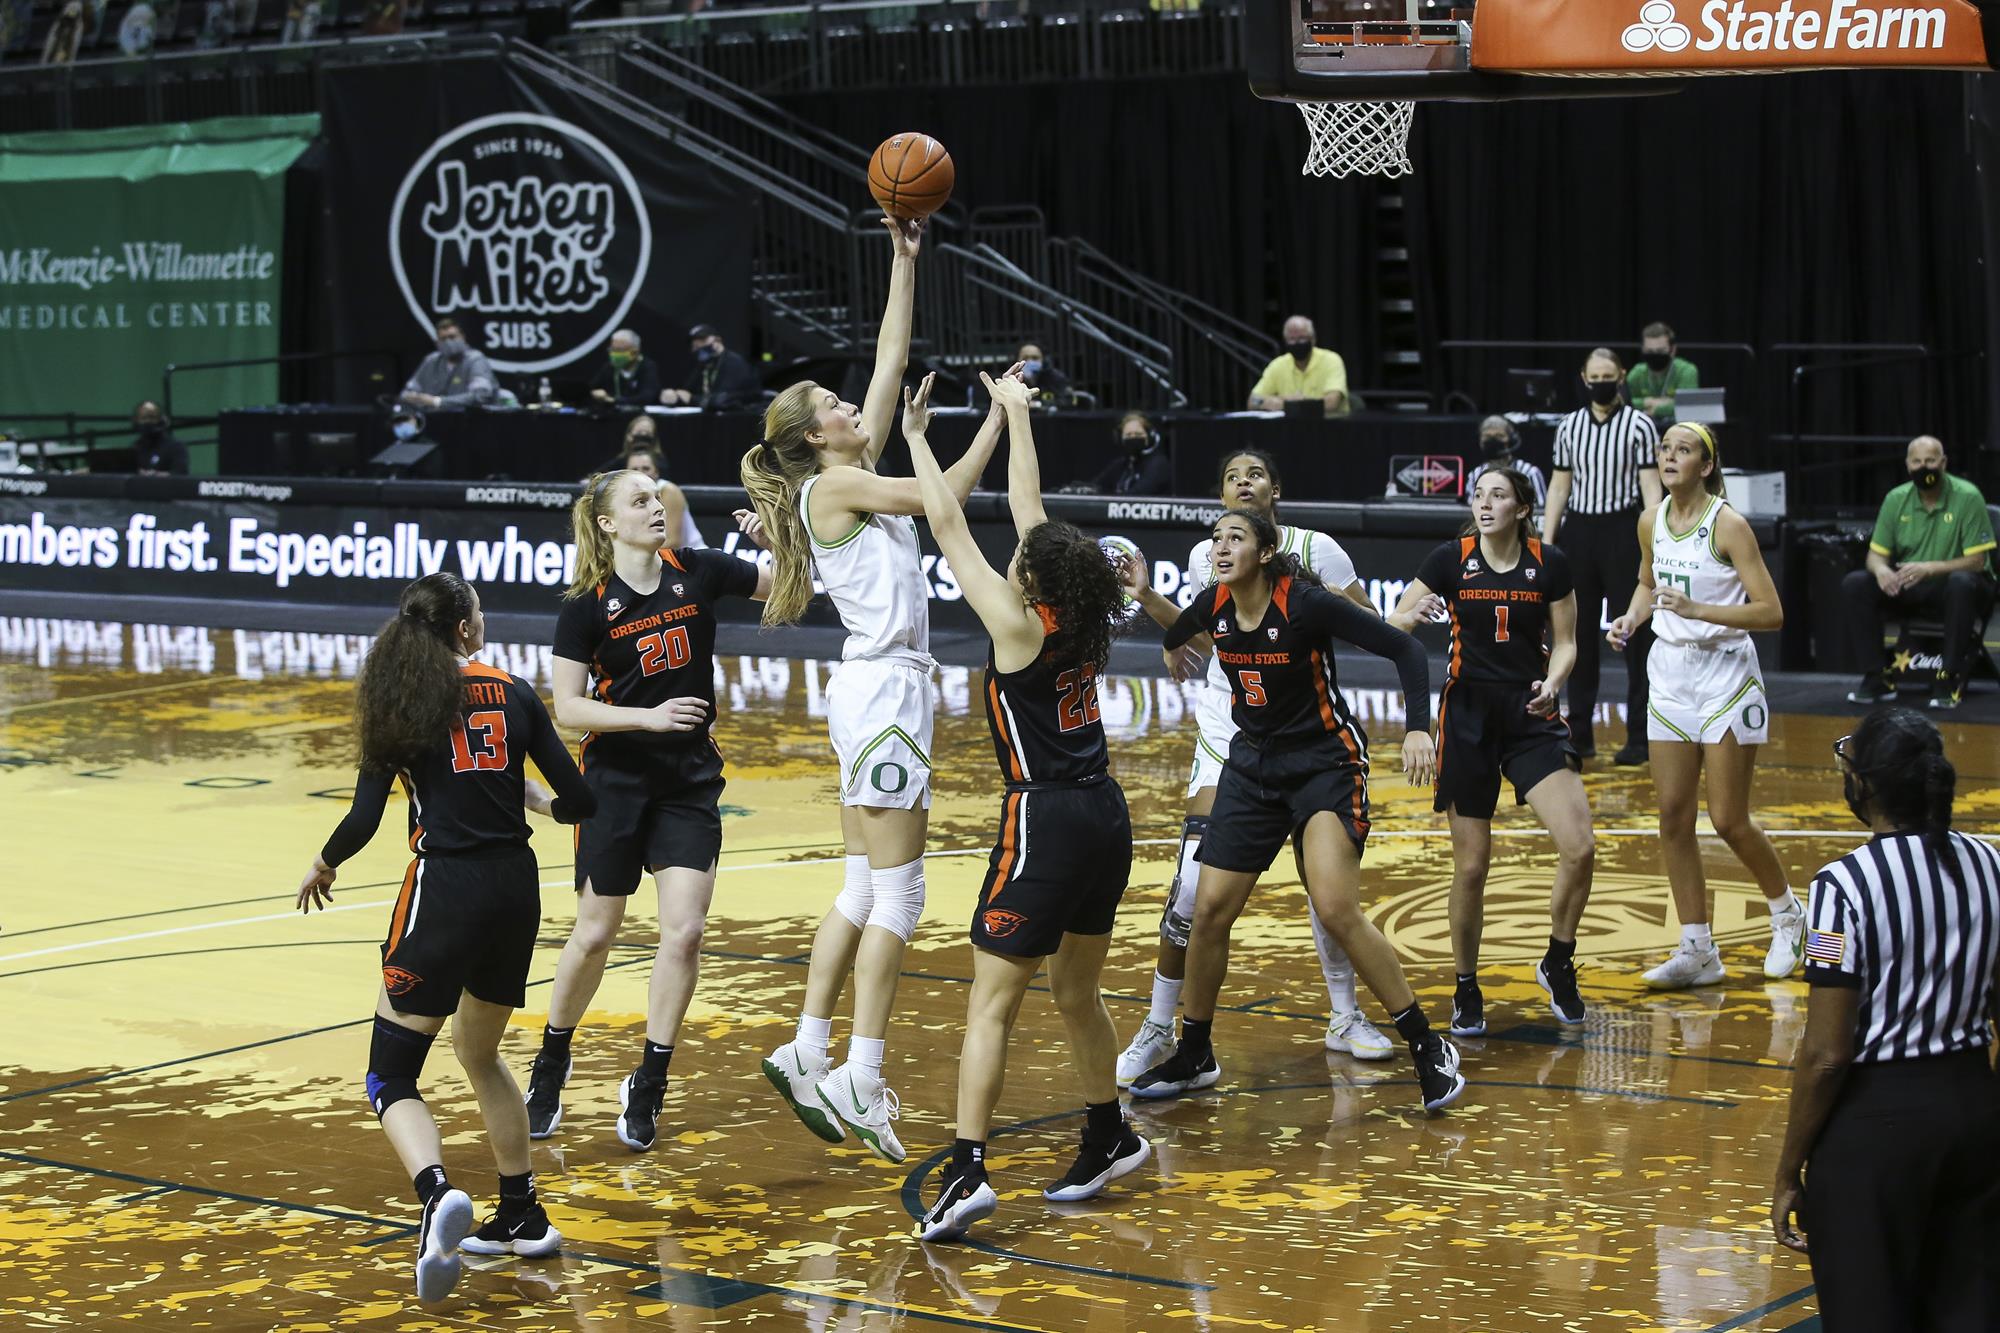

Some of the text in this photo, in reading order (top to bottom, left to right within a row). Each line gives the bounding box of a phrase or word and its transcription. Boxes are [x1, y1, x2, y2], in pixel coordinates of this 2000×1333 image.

[474, 137, 518, 160] SINCE
[421, 160, 615, 258] Jersey
[147, 301, 272, 328] CENTER
[484, 321, 553, 349] SUBS
[199, 481, 292, 501] ROCKET Mortgage
[466, 487, 572, 508] ROCKET Mortgage
[1107, 502, 1228, 526] ROCKET Mortga
[126, 512, 218, 571] first.
[228, 517, 448, 588] Especially
[1459, 589, 1508, 600] OREGON
[609, 603, 699, 640] OREGON STATE
[1495, 605, 1510, 643] 1
[636, 625, 692, 677] 20
[1217, 649, 1290, 665] REGON STATE
[1056, 661, 1101, 732] 22
[1238, 670, 1268, 707] 5
[1741, 703, 1766, 730] O
[449, 710, 509, 773] 13
[870, 761, 909, 794] O
